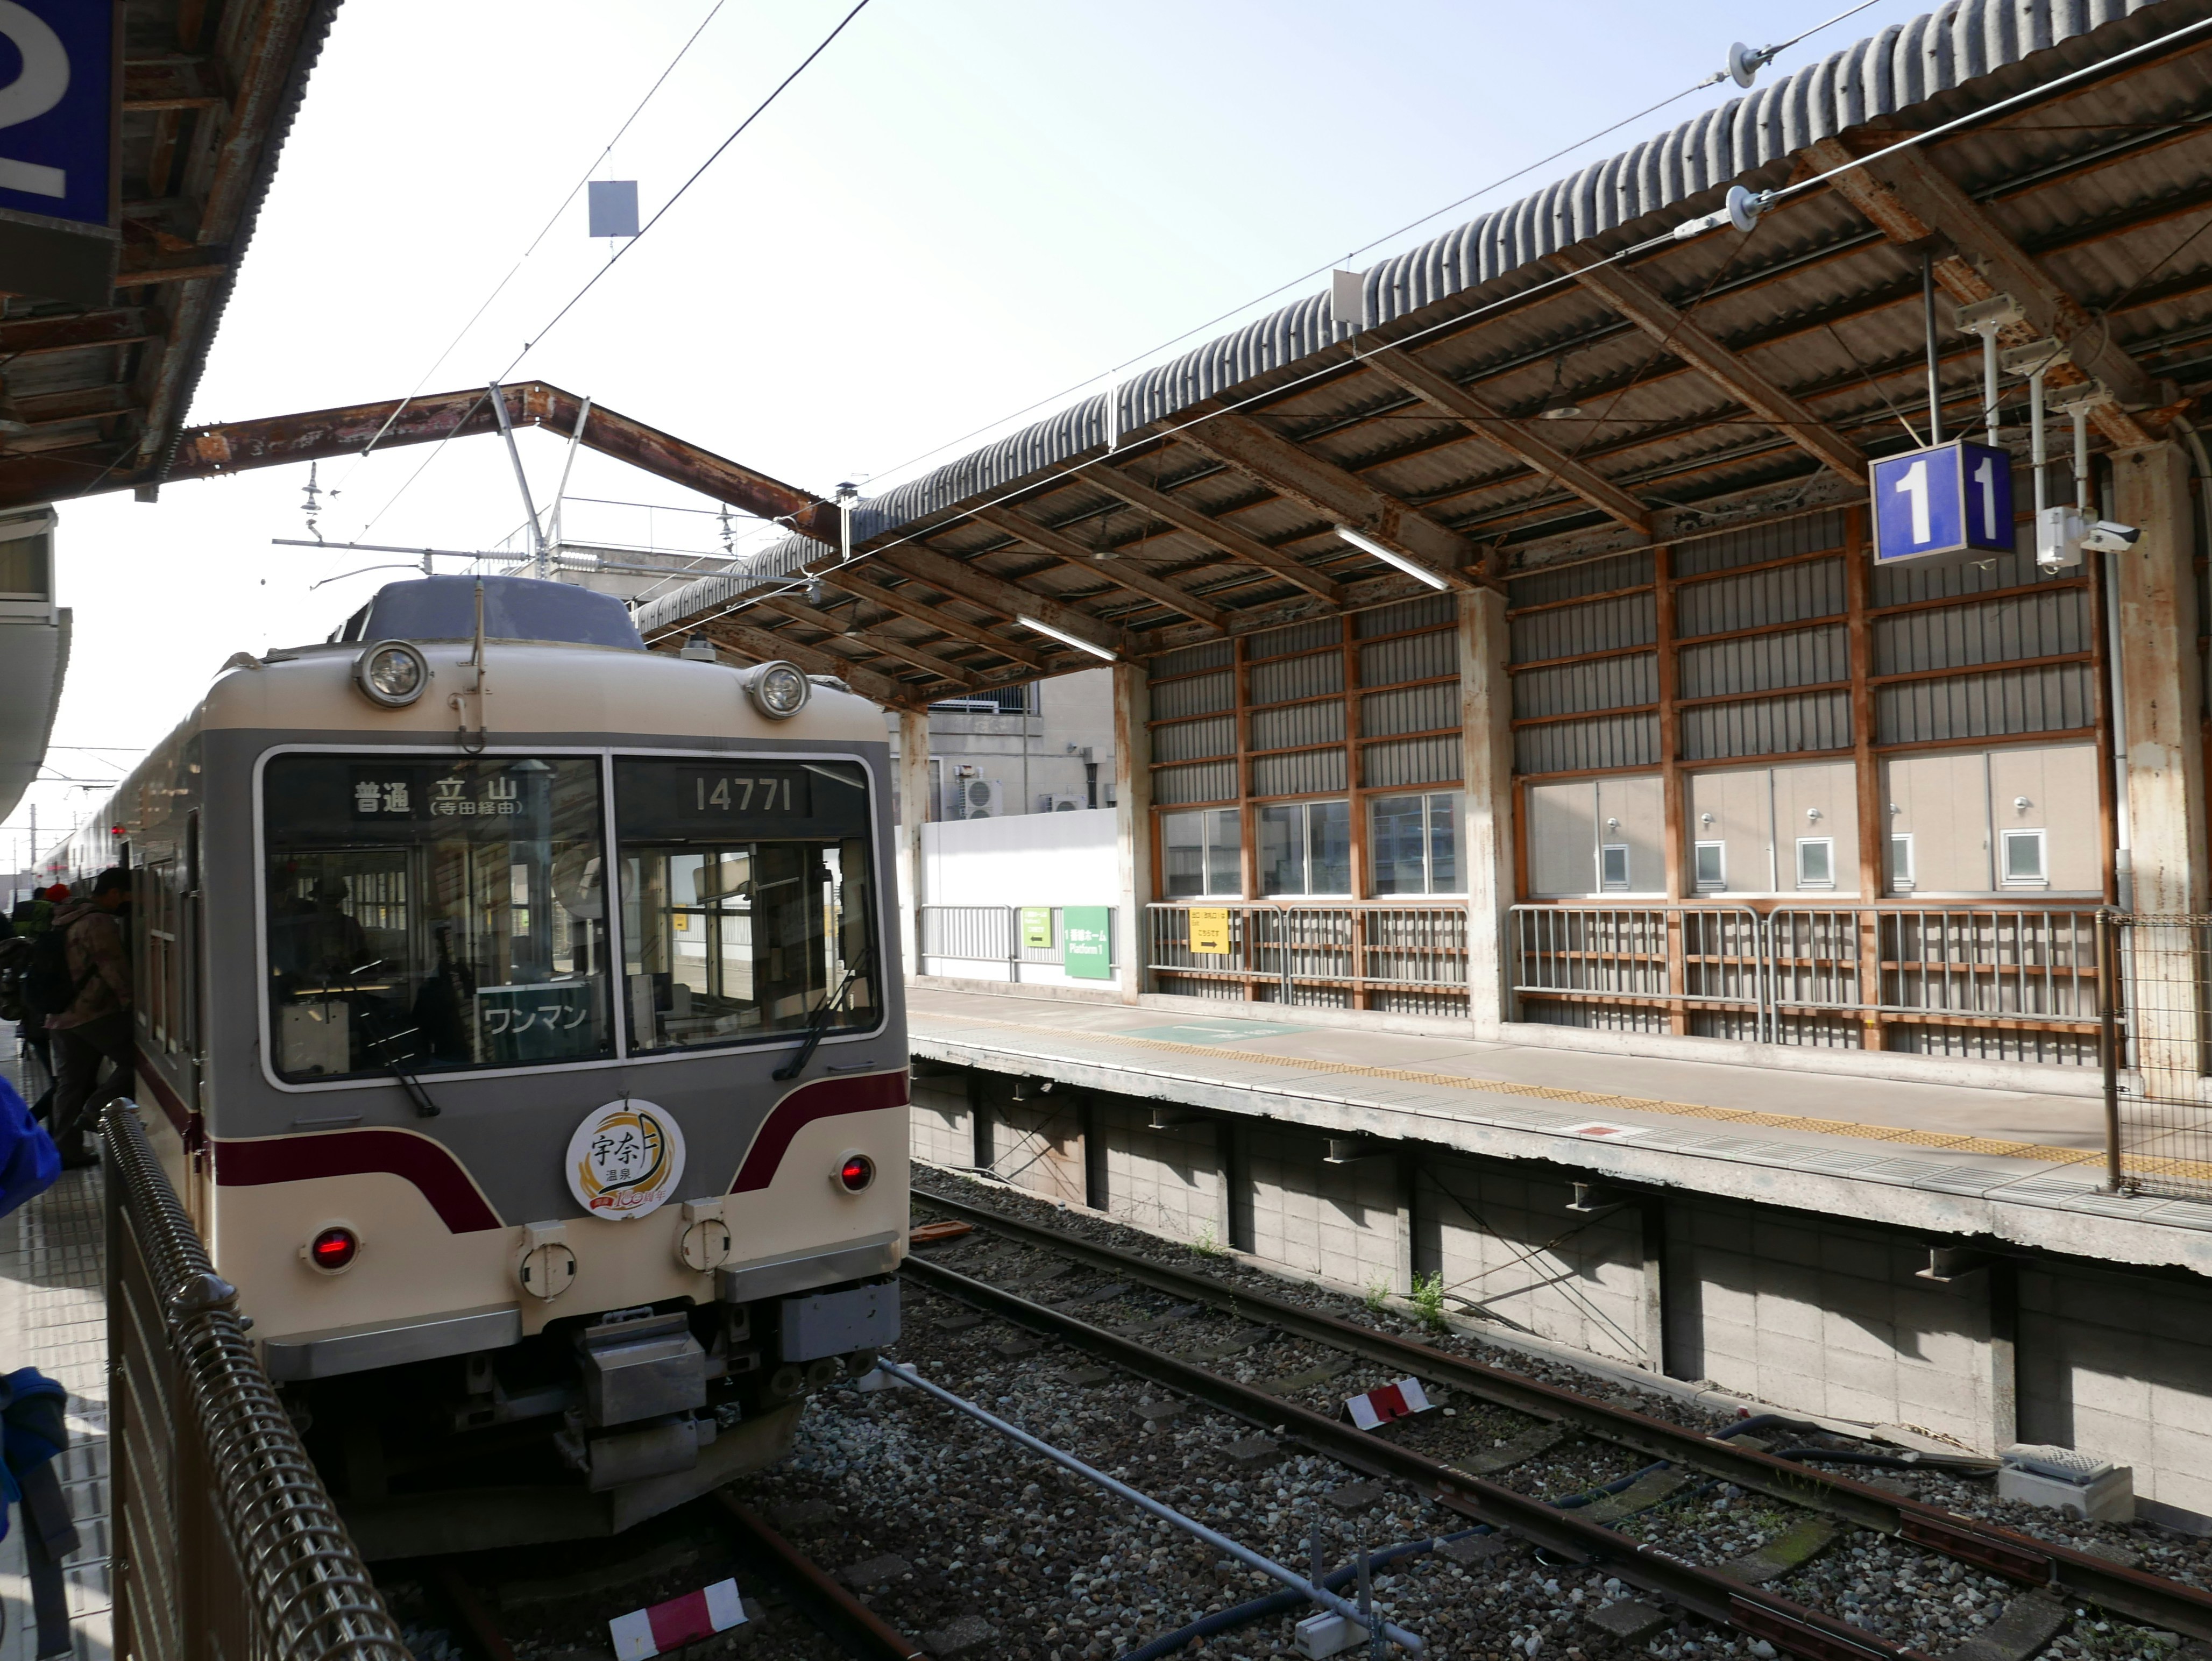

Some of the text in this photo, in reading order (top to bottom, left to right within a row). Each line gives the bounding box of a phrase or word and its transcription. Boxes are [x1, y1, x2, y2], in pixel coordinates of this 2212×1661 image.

[1896, 460, 1931, 544] 1
[1974, 457, 1996, 540] 1
[355, 782, 410, 812] 普通
[697, 778, 790, 810] 14771
[1069, 943, 1102, 955] Platform 1
[485, 1005, 586, 1034] ワンマン
[606, 1168, 632, 1182] 温泉
